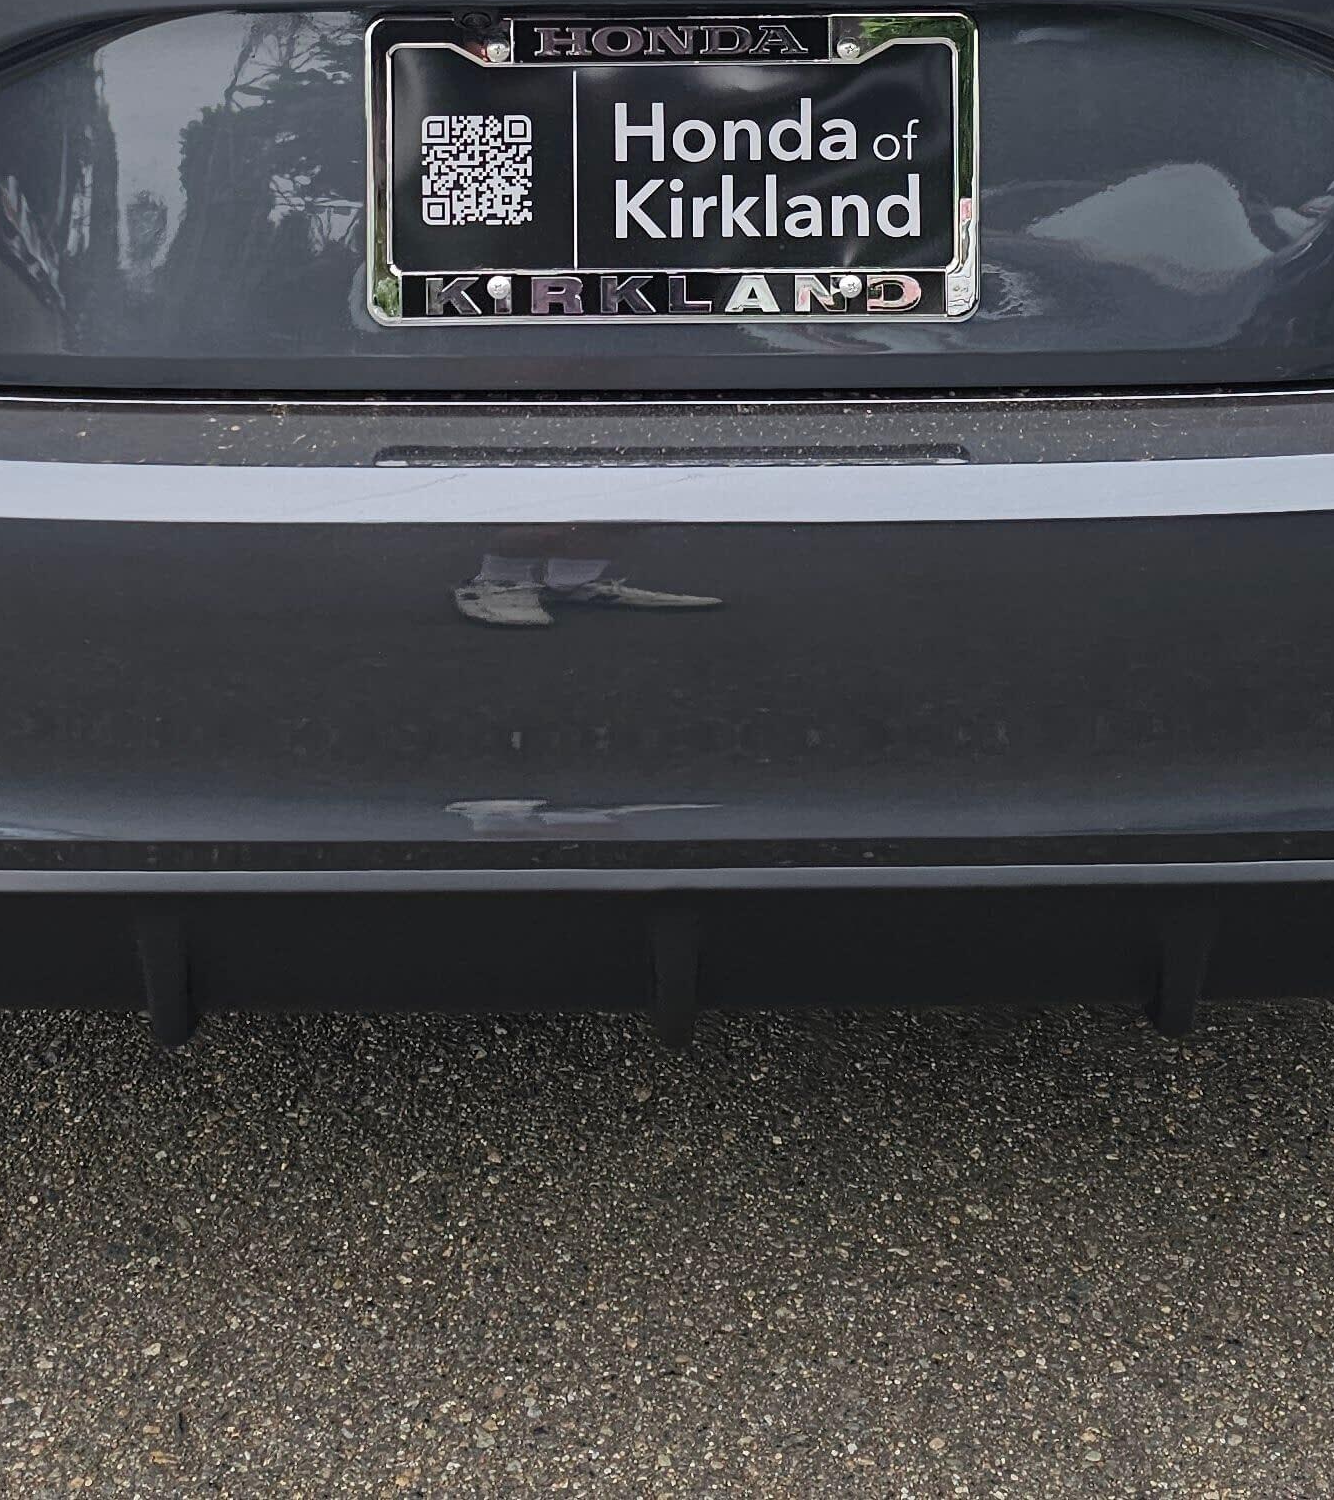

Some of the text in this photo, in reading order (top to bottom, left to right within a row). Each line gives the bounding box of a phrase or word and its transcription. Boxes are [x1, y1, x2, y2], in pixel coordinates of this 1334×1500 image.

[533, 25, 808, 57] HONDA
[614, 98, 919, 163] Honda of
[615, 173, 921, 240] Kirkland
